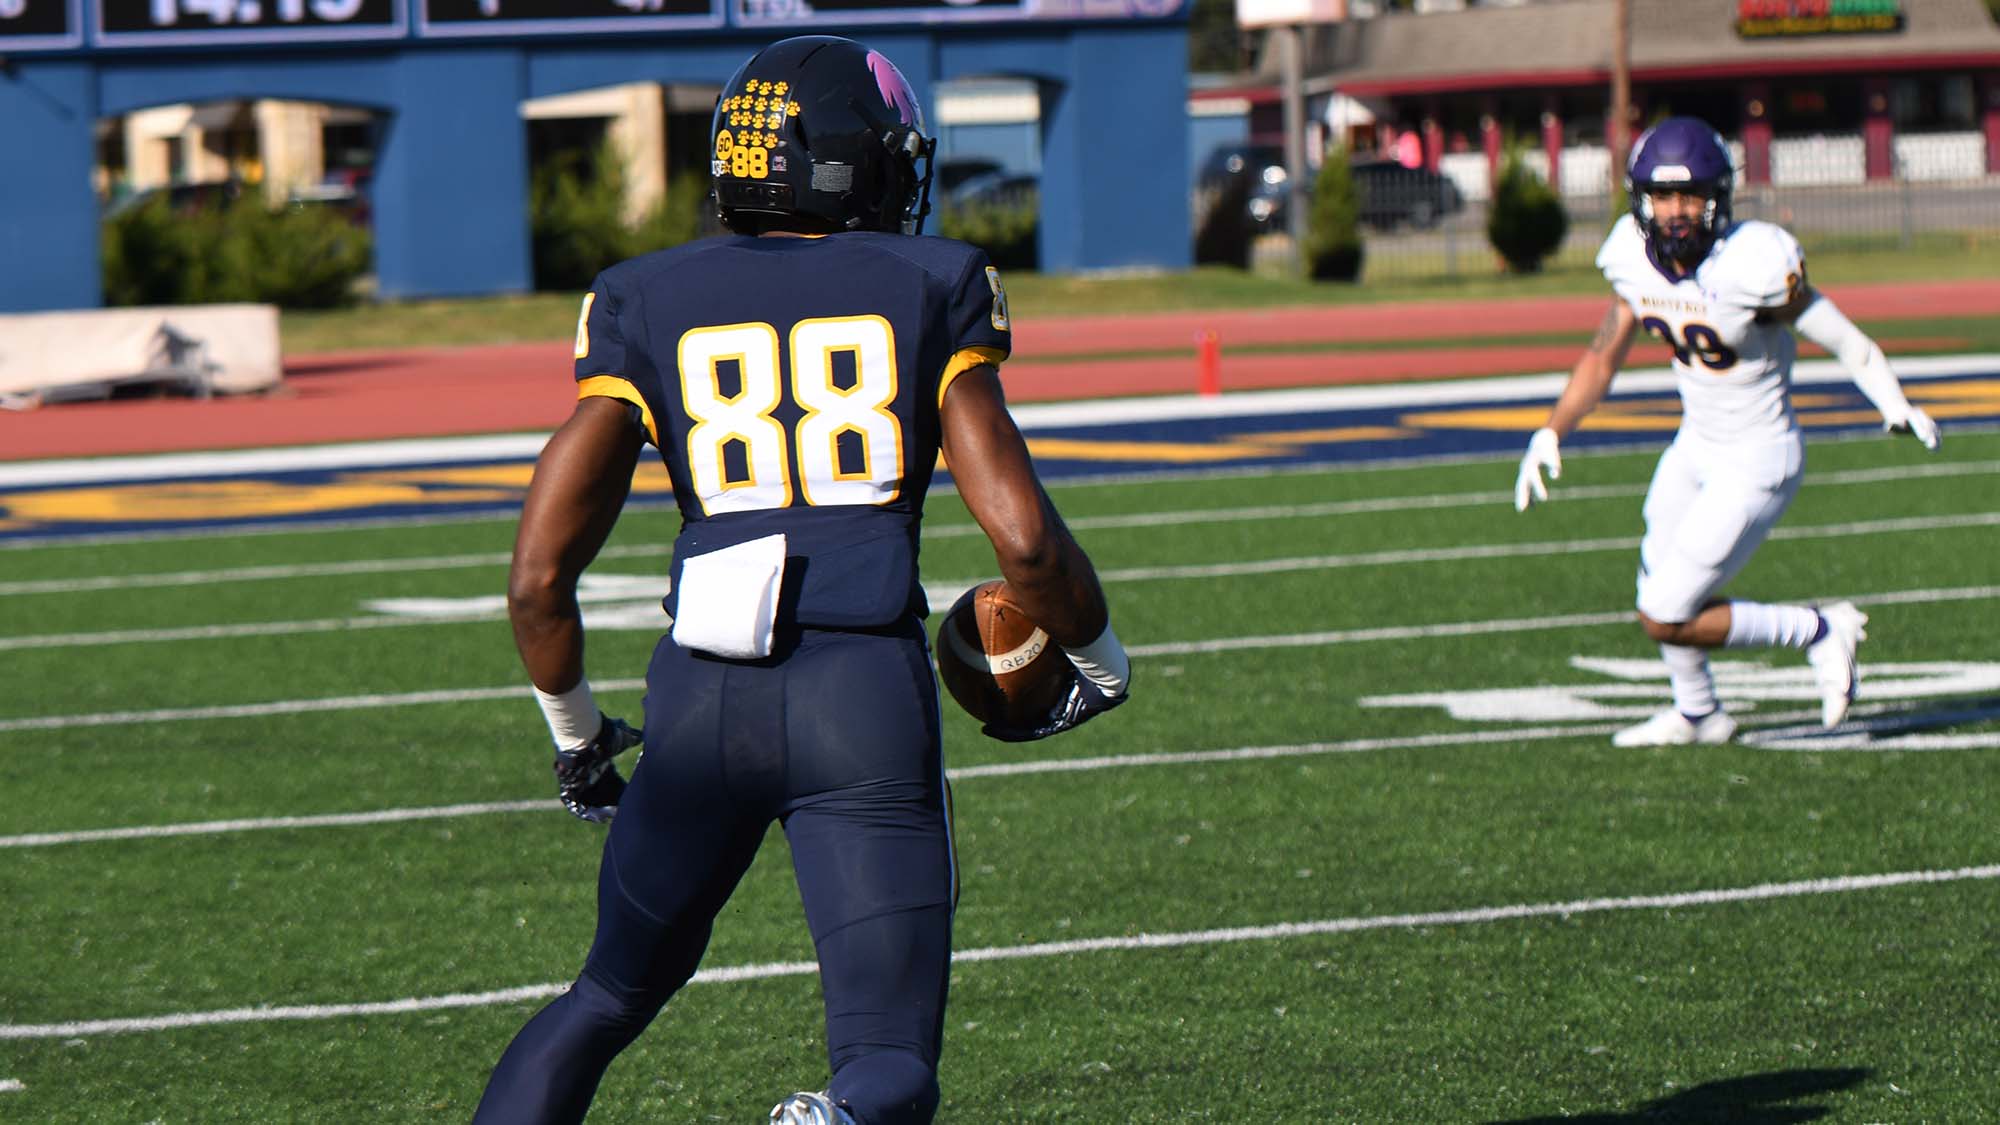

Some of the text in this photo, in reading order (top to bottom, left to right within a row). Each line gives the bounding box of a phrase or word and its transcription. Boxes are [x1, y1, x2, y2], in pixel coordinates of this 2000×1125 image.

[718, 137, 731, 152] GC
[731, 145, 768, 179] 88
[678, 314, 904, 517] 88
